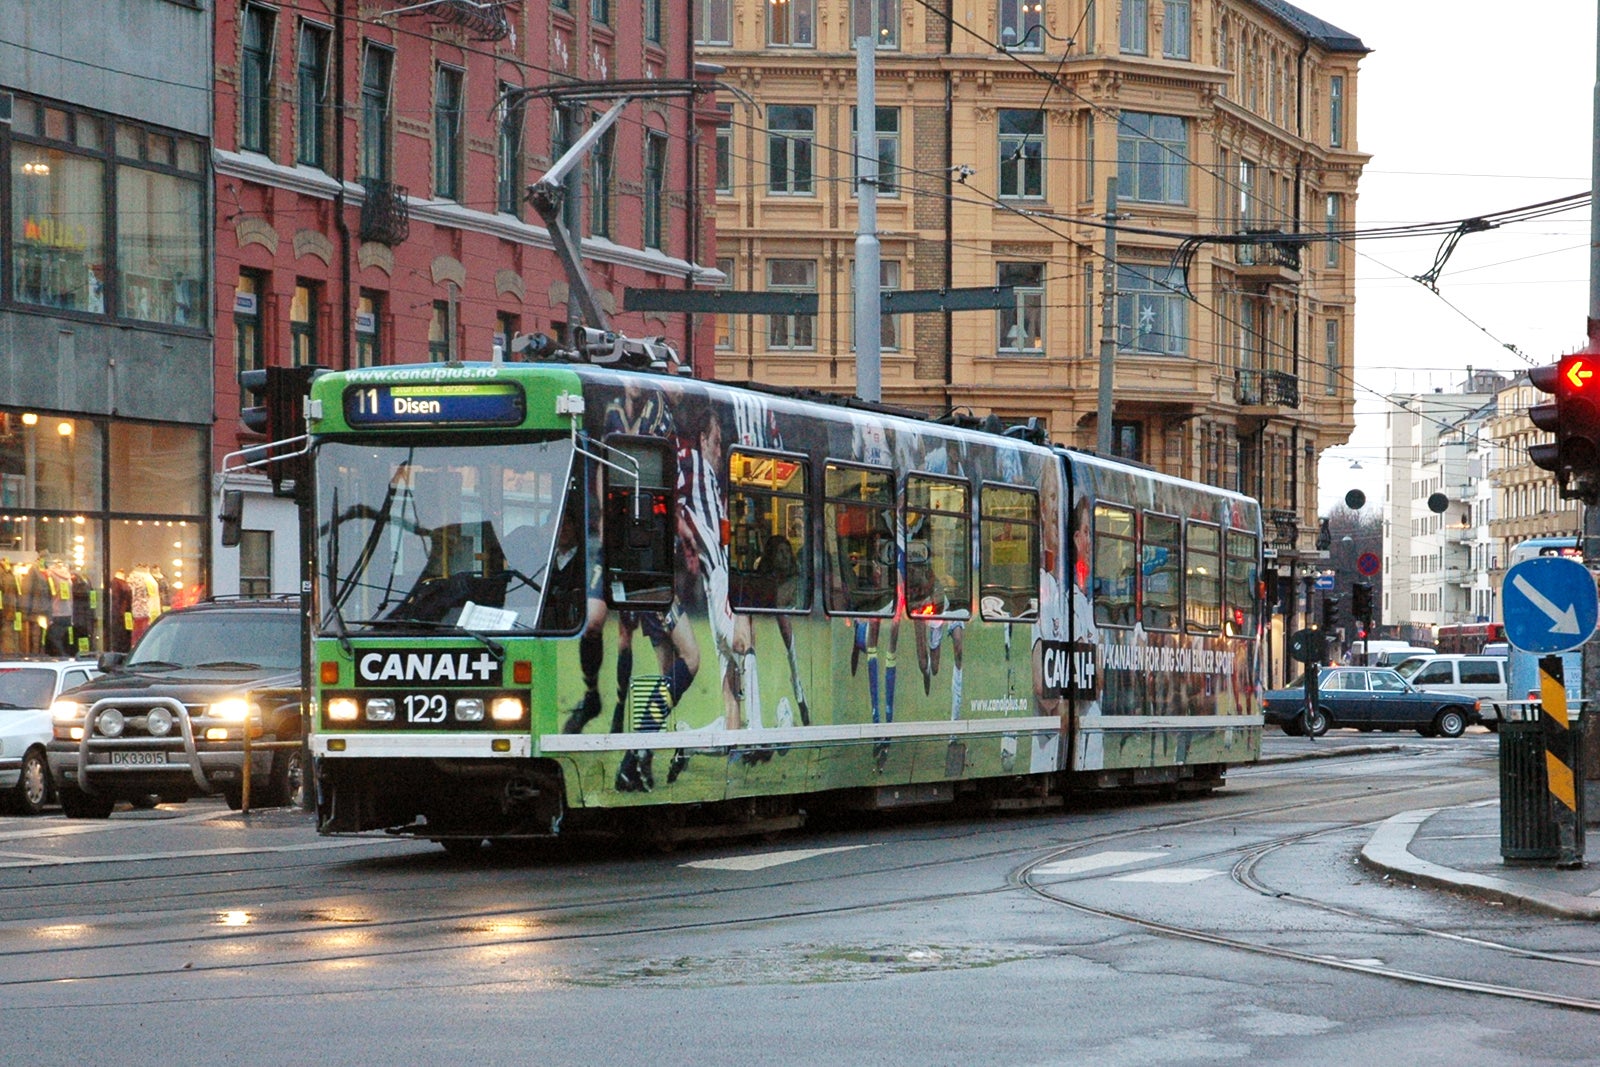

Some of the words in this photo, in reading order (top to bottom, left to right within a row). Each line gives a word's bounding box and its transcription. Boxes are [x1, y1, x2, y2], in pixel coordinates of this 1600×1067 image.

[345, 368, 498, 382] www.canalplus.no
[355, 388, 378, 414] 11
[394, 397, 440, 414] Disen
[360, 653, 498, 681] CANAL+
[1145, 646, 1160, 672] FOR
[1176, 648, 1191, 673] SOM
[1215, 650, 1235, 675] SPORT
[403, 694, 447, 723] 129
